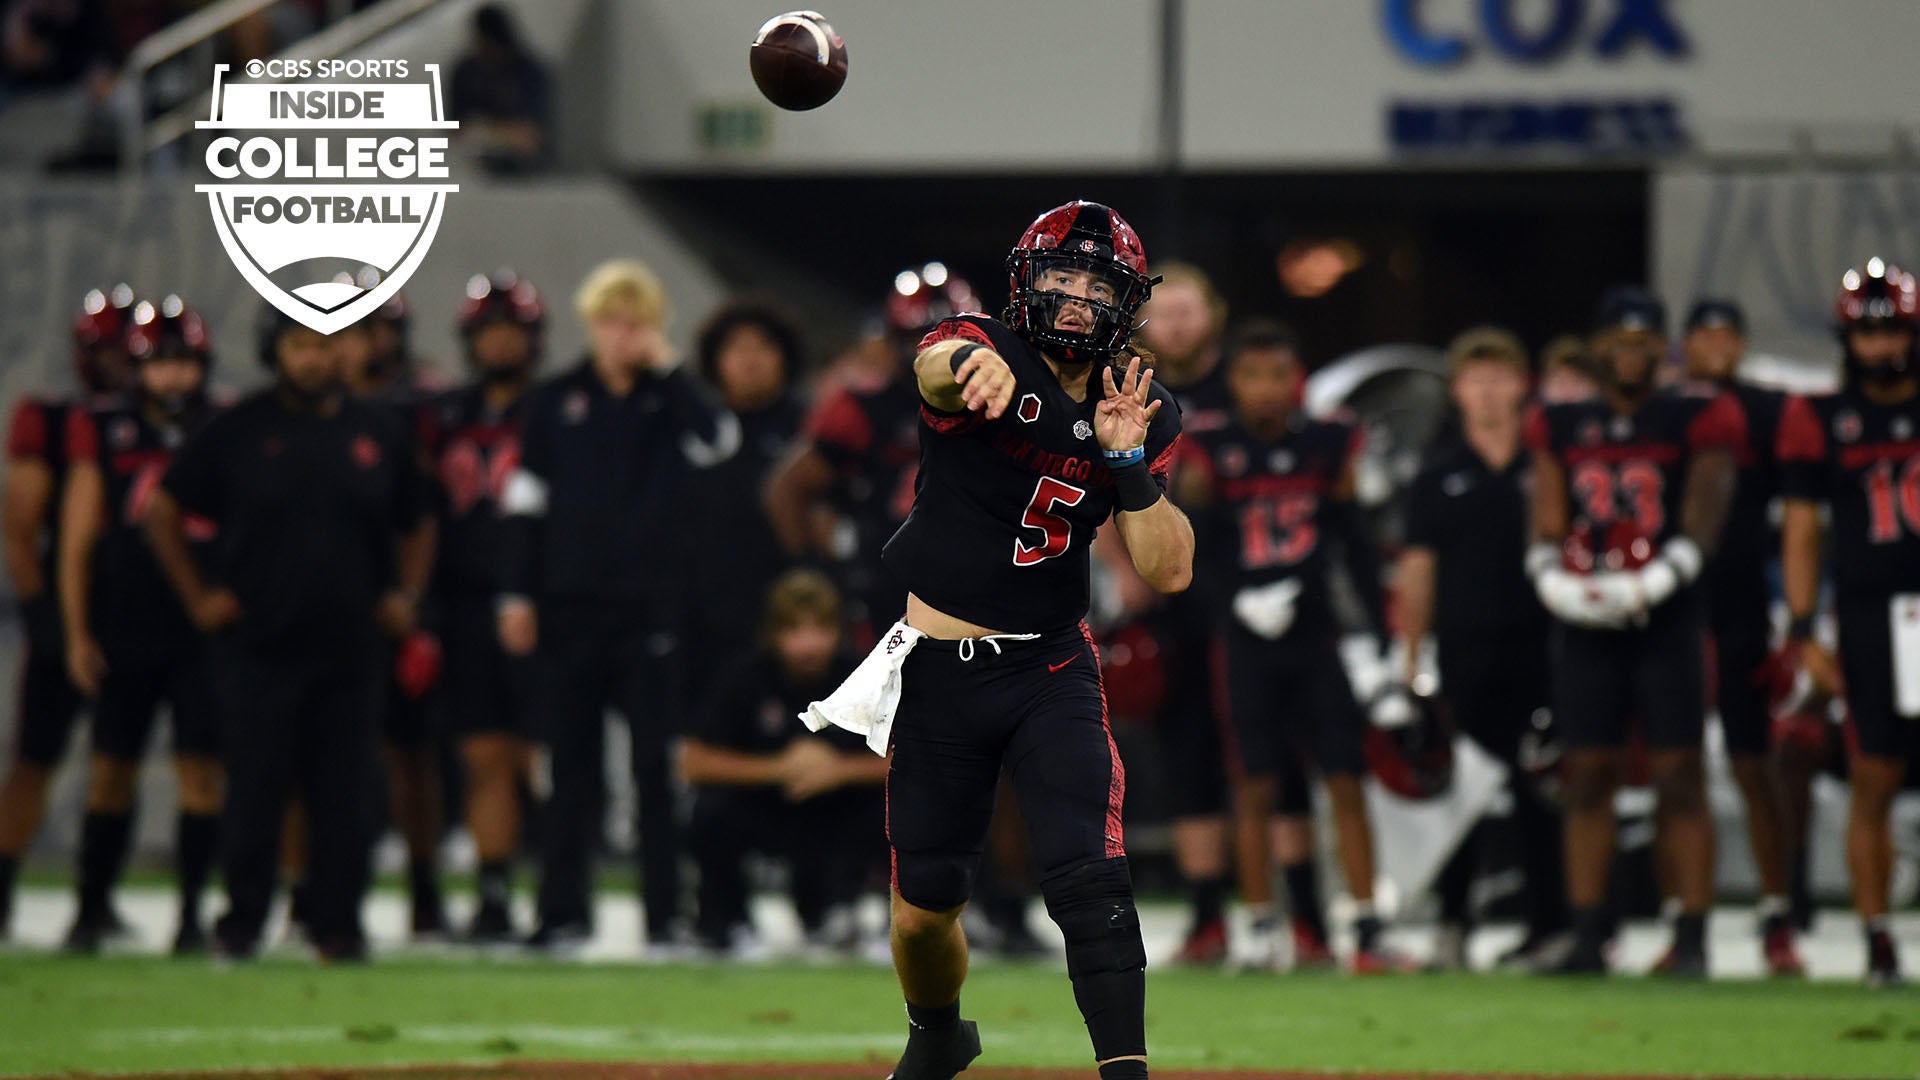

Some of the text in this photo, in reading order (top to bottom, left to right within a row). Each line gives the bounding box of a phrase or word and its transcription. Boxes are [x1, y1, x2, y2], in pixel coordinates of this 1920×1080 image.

[1029, 448, 1092, 483] DIEGO
[1572, 460, 1664, 537] 33
[1013, 475, 1086, 567] 5
[1240, 494, 1318, 569] 15
